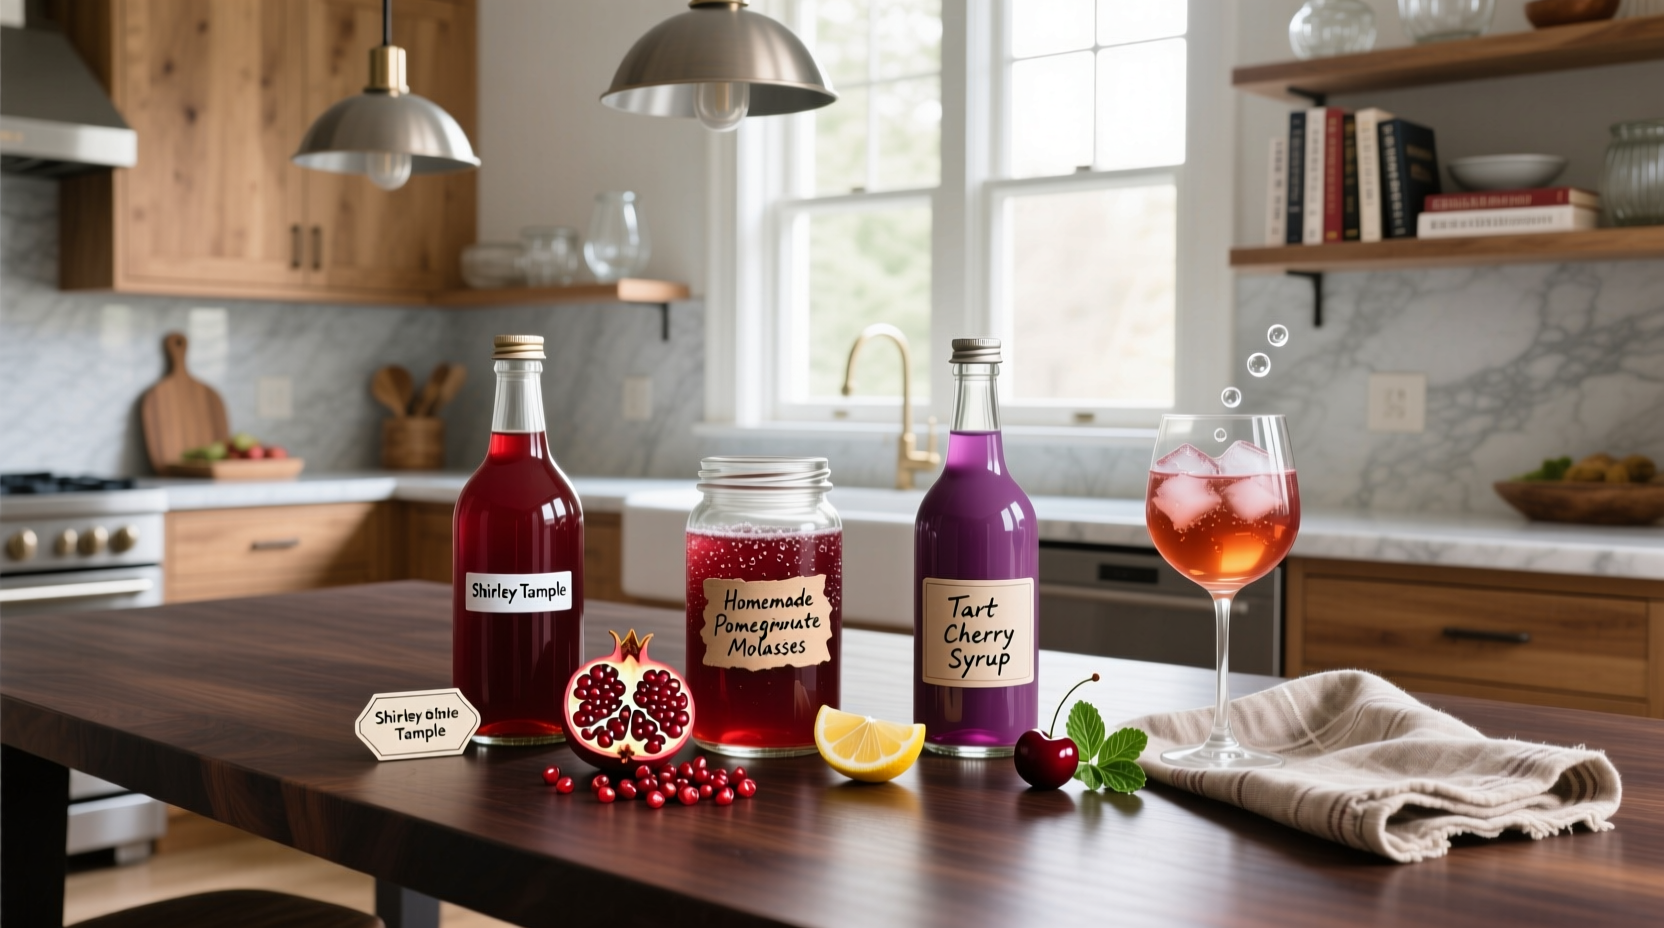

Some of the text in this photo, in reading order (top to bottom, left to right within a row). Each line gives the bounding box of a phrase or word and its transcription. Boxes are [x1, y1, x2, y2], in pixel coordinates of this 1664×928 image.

[472, 580, 566, 604] Shirley Tample
[723, 587, 813, 611] Homemade
[947, 594, 998, 619] Tart
[727, 637, 806, 658] Molasses
[943, 621, 1015, 651] Cherry
[947, 647, 1011, 679] Syrup
[375, 708, 423, 726] Shirley
[395, 722, 446, 743] Tample
